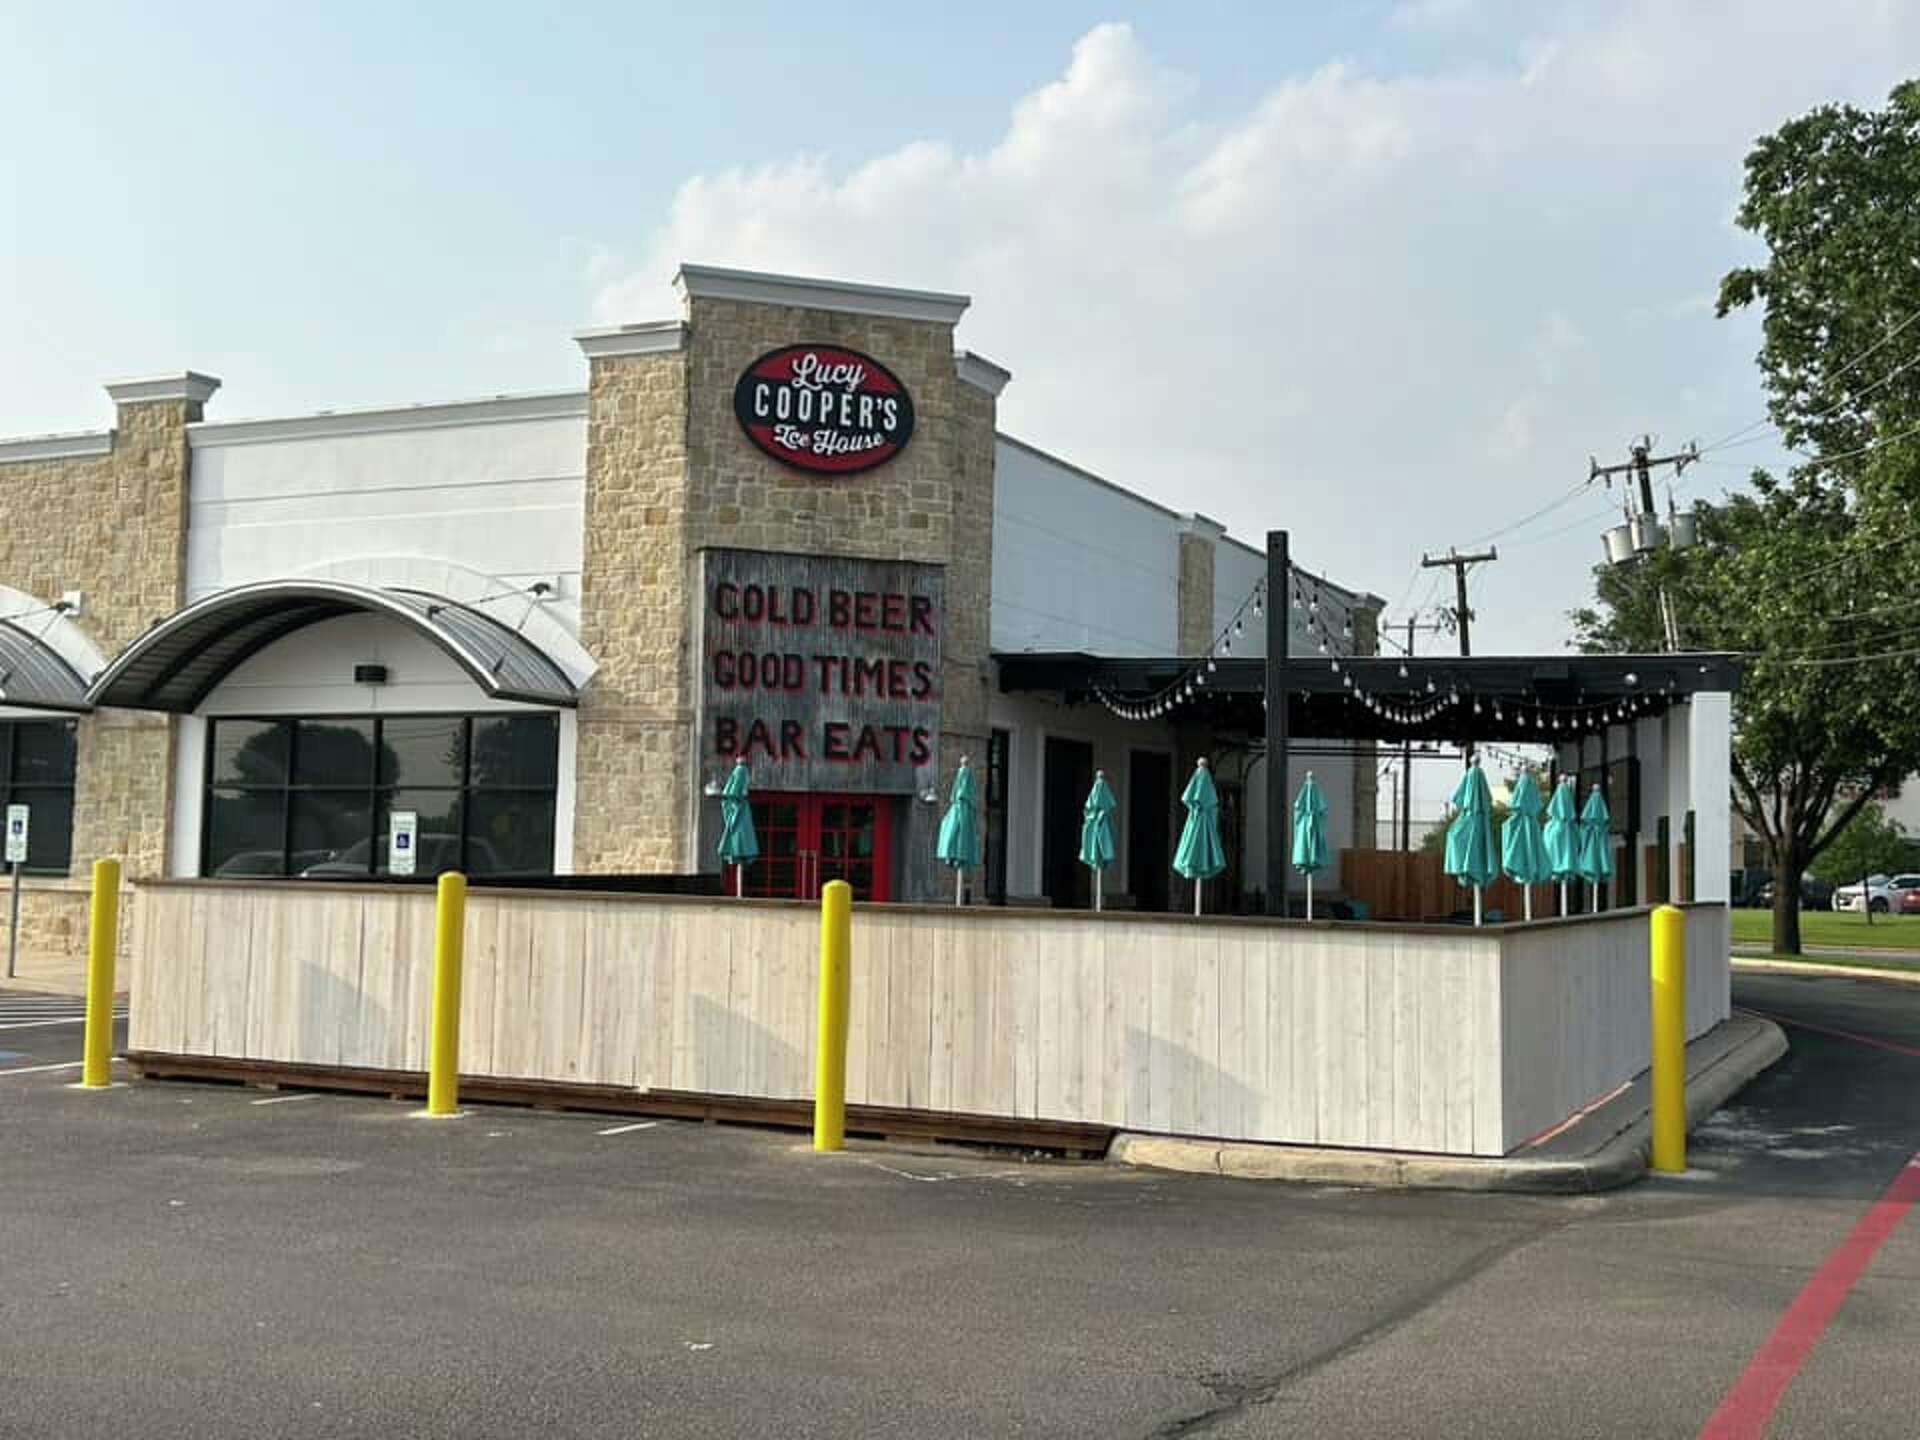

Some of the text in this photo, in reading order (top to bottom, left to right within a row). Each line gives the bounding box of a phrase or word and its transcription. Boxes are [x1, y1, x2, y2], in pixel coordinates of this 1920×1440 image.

[791, 353, 864, 391] Lucy
[754, 383, 898, 431] COOPER'S
[773, 423, 884, 456] Ice House
[715, 582, 935, 635] COLD BEER
[713, 650, 933, 702] GOOD TIMES
[714, 717, 932, 766] BAR EATS
